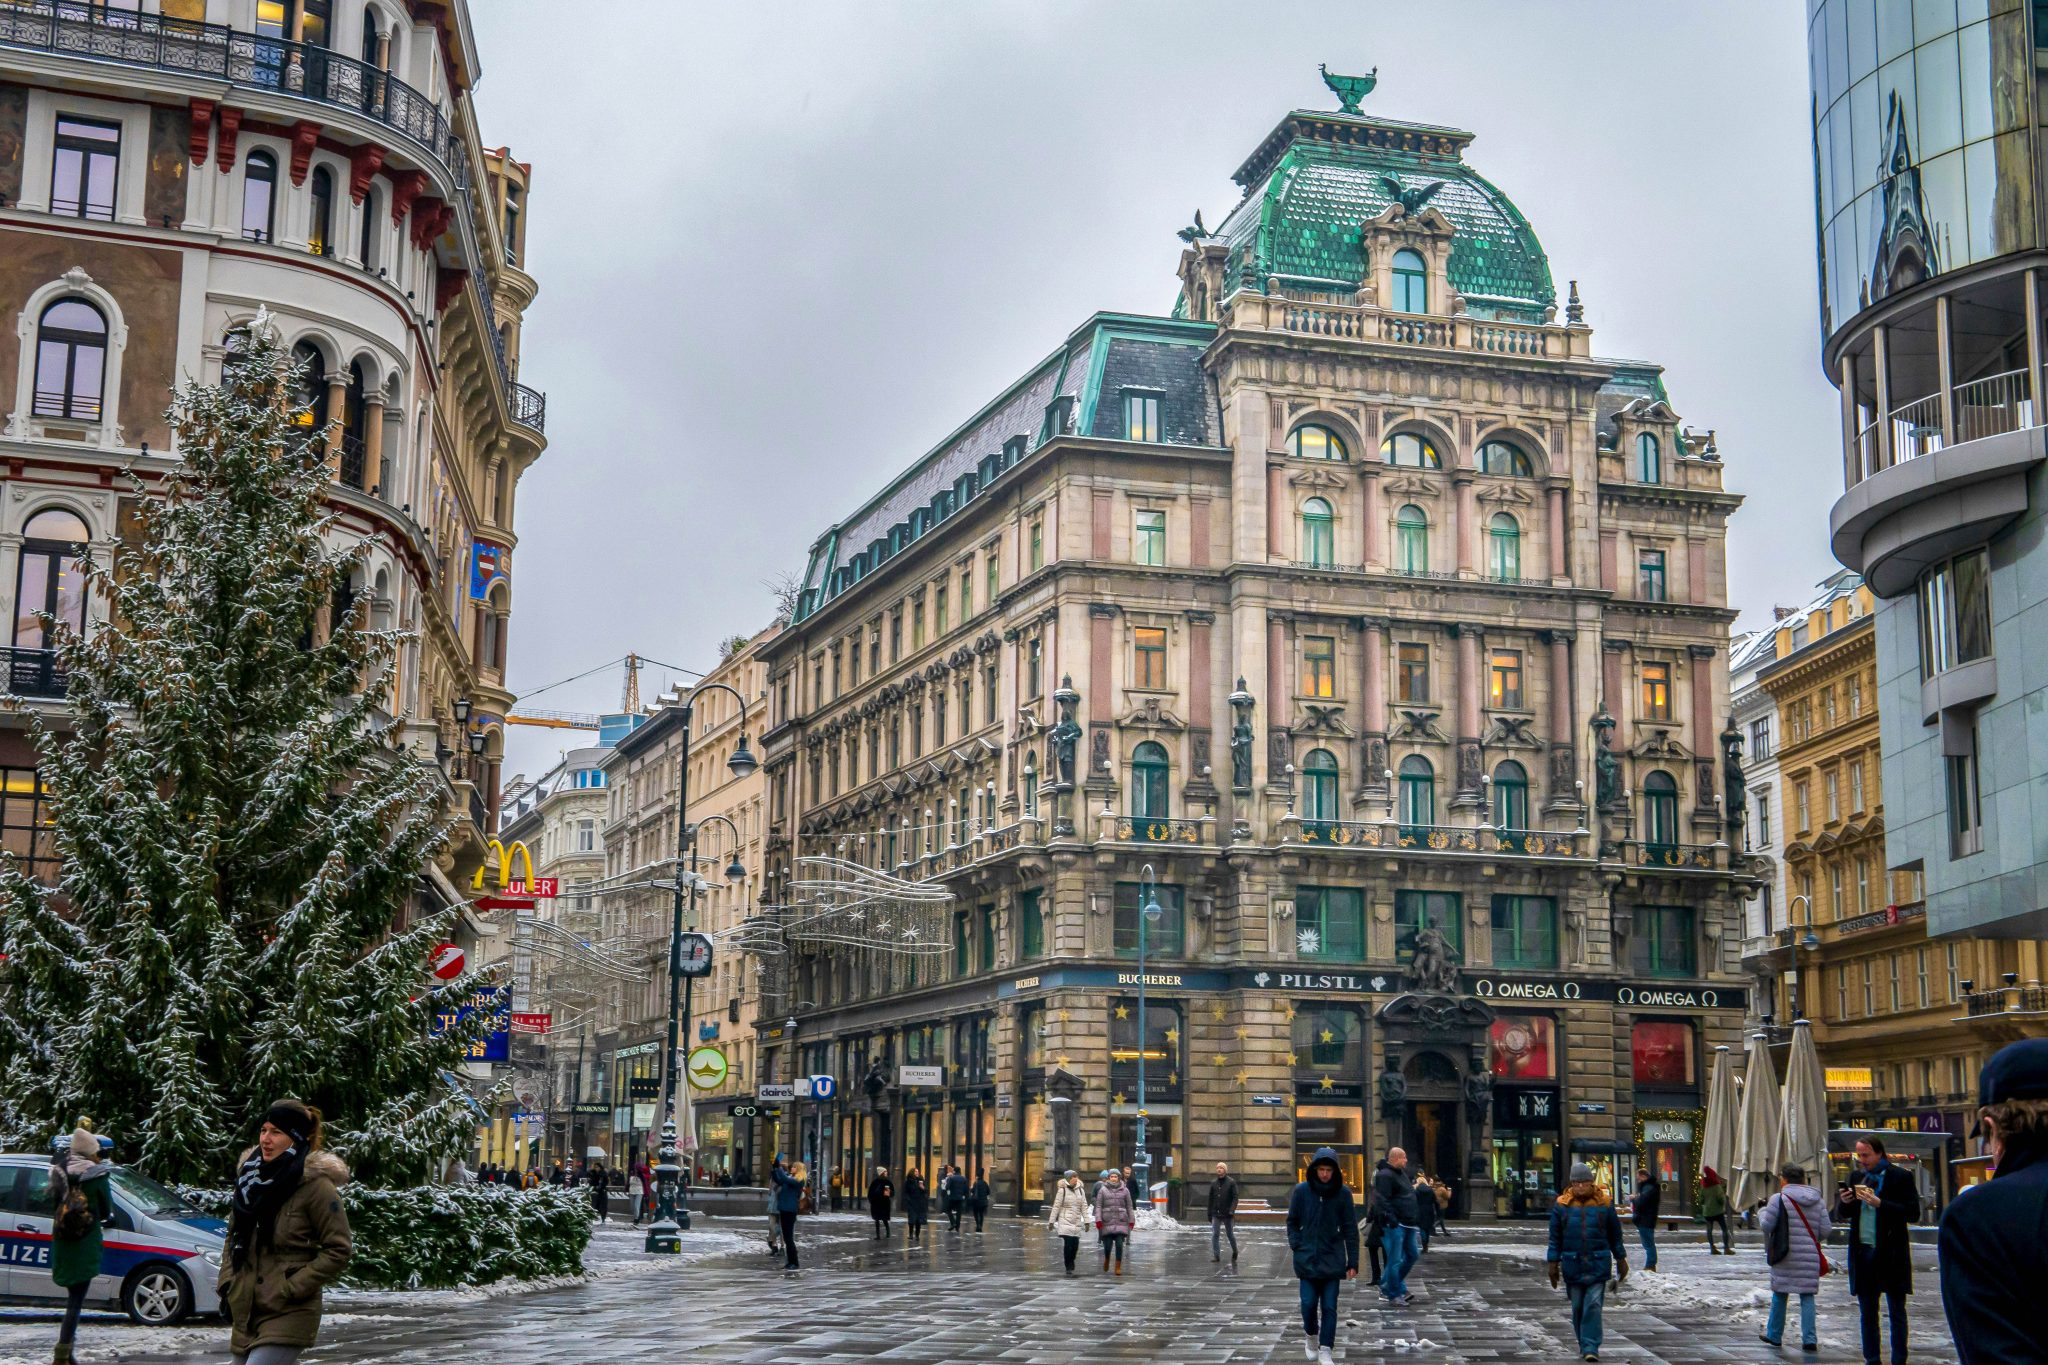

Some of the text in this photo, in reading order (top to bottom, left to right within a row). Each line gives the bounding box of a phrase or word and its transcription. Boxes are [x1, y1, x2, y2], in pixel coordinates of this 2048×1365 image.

[1015, 976, 1040, 990] BUCHERER
[1118, 974, 1182, 986] BUCHERER
[1279, 974, 1362, 990] PILSTL
[1498, 983, 1558, 998] OMEGA
[1640, 991, 1697, 1006] OMEGA
[761, 1087, 793, 1097] claire's
[816, 1080, 832, 1097] U
[1653, 1131, 1685, 1141] OMEGA
